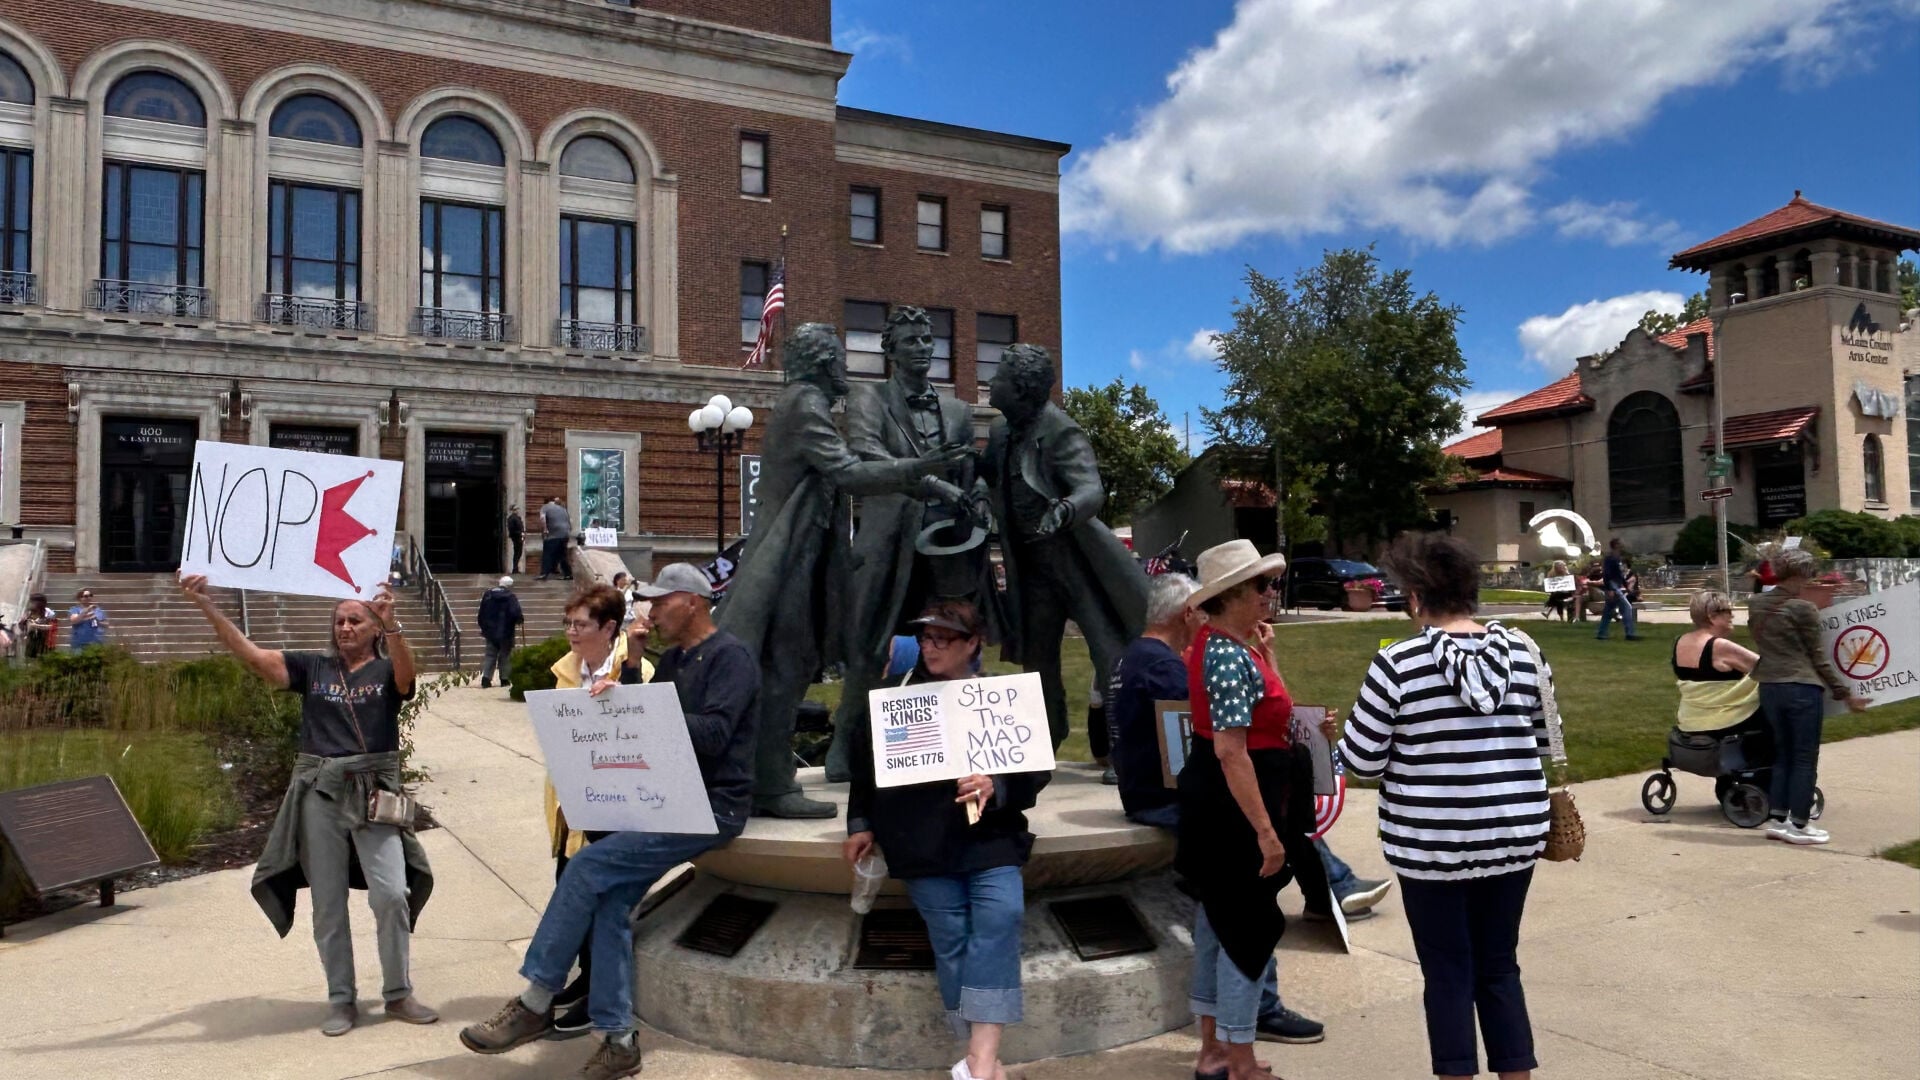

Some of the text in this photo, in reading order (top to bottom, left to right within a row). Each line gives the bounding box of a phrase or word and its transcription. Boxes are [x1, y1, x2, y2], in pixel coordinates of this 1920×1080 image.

[1844, 602, 1887, 625] KINGS
[1856, 669, 1918, 695] AMERICA
[553, 702, 583, 718] When
[882, 694, 938, 713] RESISTING
[890, 707, 933, 726] KINGS
[972, 707, 1016, 728] The
[615, 727, 639, 740] Law
[967, 724, 1032, 750] MAD
[886, 751, 945, 770] SINCE 1776
[966, 745, 1025, 772] KING
[585, 785, 666, 809] Becomes Duty
